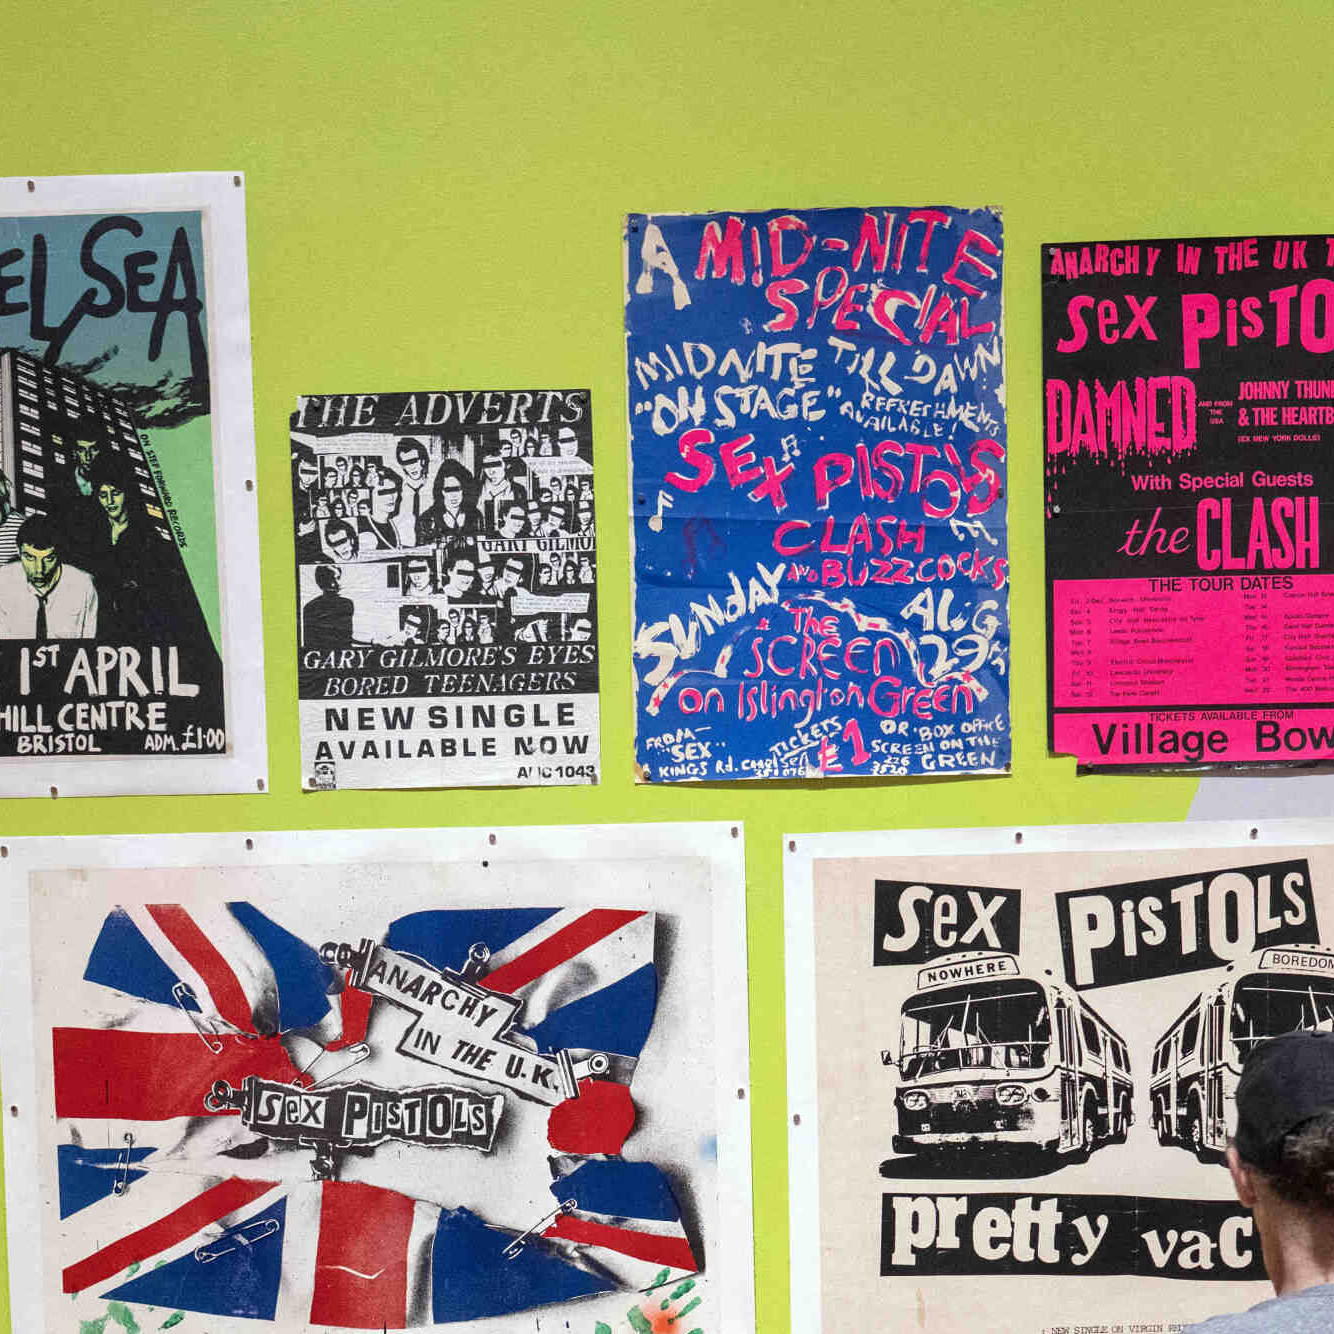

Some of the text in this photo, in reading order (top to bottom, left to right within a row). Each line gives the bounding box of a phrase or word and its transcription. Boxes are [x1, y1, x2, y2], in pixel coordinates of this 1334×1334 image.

[635, 223, 692, 310] A
[1051, 244, 1162, 280] ANARCHY
[1177, 243, 1202, 275] IN
[1214, 238, 1260, 275] THE
[1273, 240, 1308, 270] UK
[763, 266, 995, 345] SPECIAL
[1238, 381, 1290, 400] JOHNNY
[296, 391, 584, 428] THE ADVERTS
[1045, 376, 1197, 457] DAMNED
[1238, 409, 1249, 426] &
[1252, 408, 1278, 426] THE
[1131, 471, 1314, 491] With Special Guests
[772, 513, 926, 557] CLASH
[64, 646, 200, 697] APRIL
[303, 645, 596, 670] GARY GILMORE'S EYES
[324, 671, 577, 697] BORED TEENAGERS
[57, 701, 167, 731] CENTRE
[325, 702, 576, 731] NEW SINGLE
[17, 732, 102, 755] BRISTOL
[315, 735, 590, 760] AVAILABLE NOW
[1091, 723, 1229, 762] Village
[927, 960, 1007, 984] NOWHERE
[369, 961, 500, 1029] ANARCHY
[414, 1027, 561, 1091] IN THE U.K.
[1112, 1325, 1124, 1334] ON
[1129, 1323, 1165, 1334] VIRGIN
